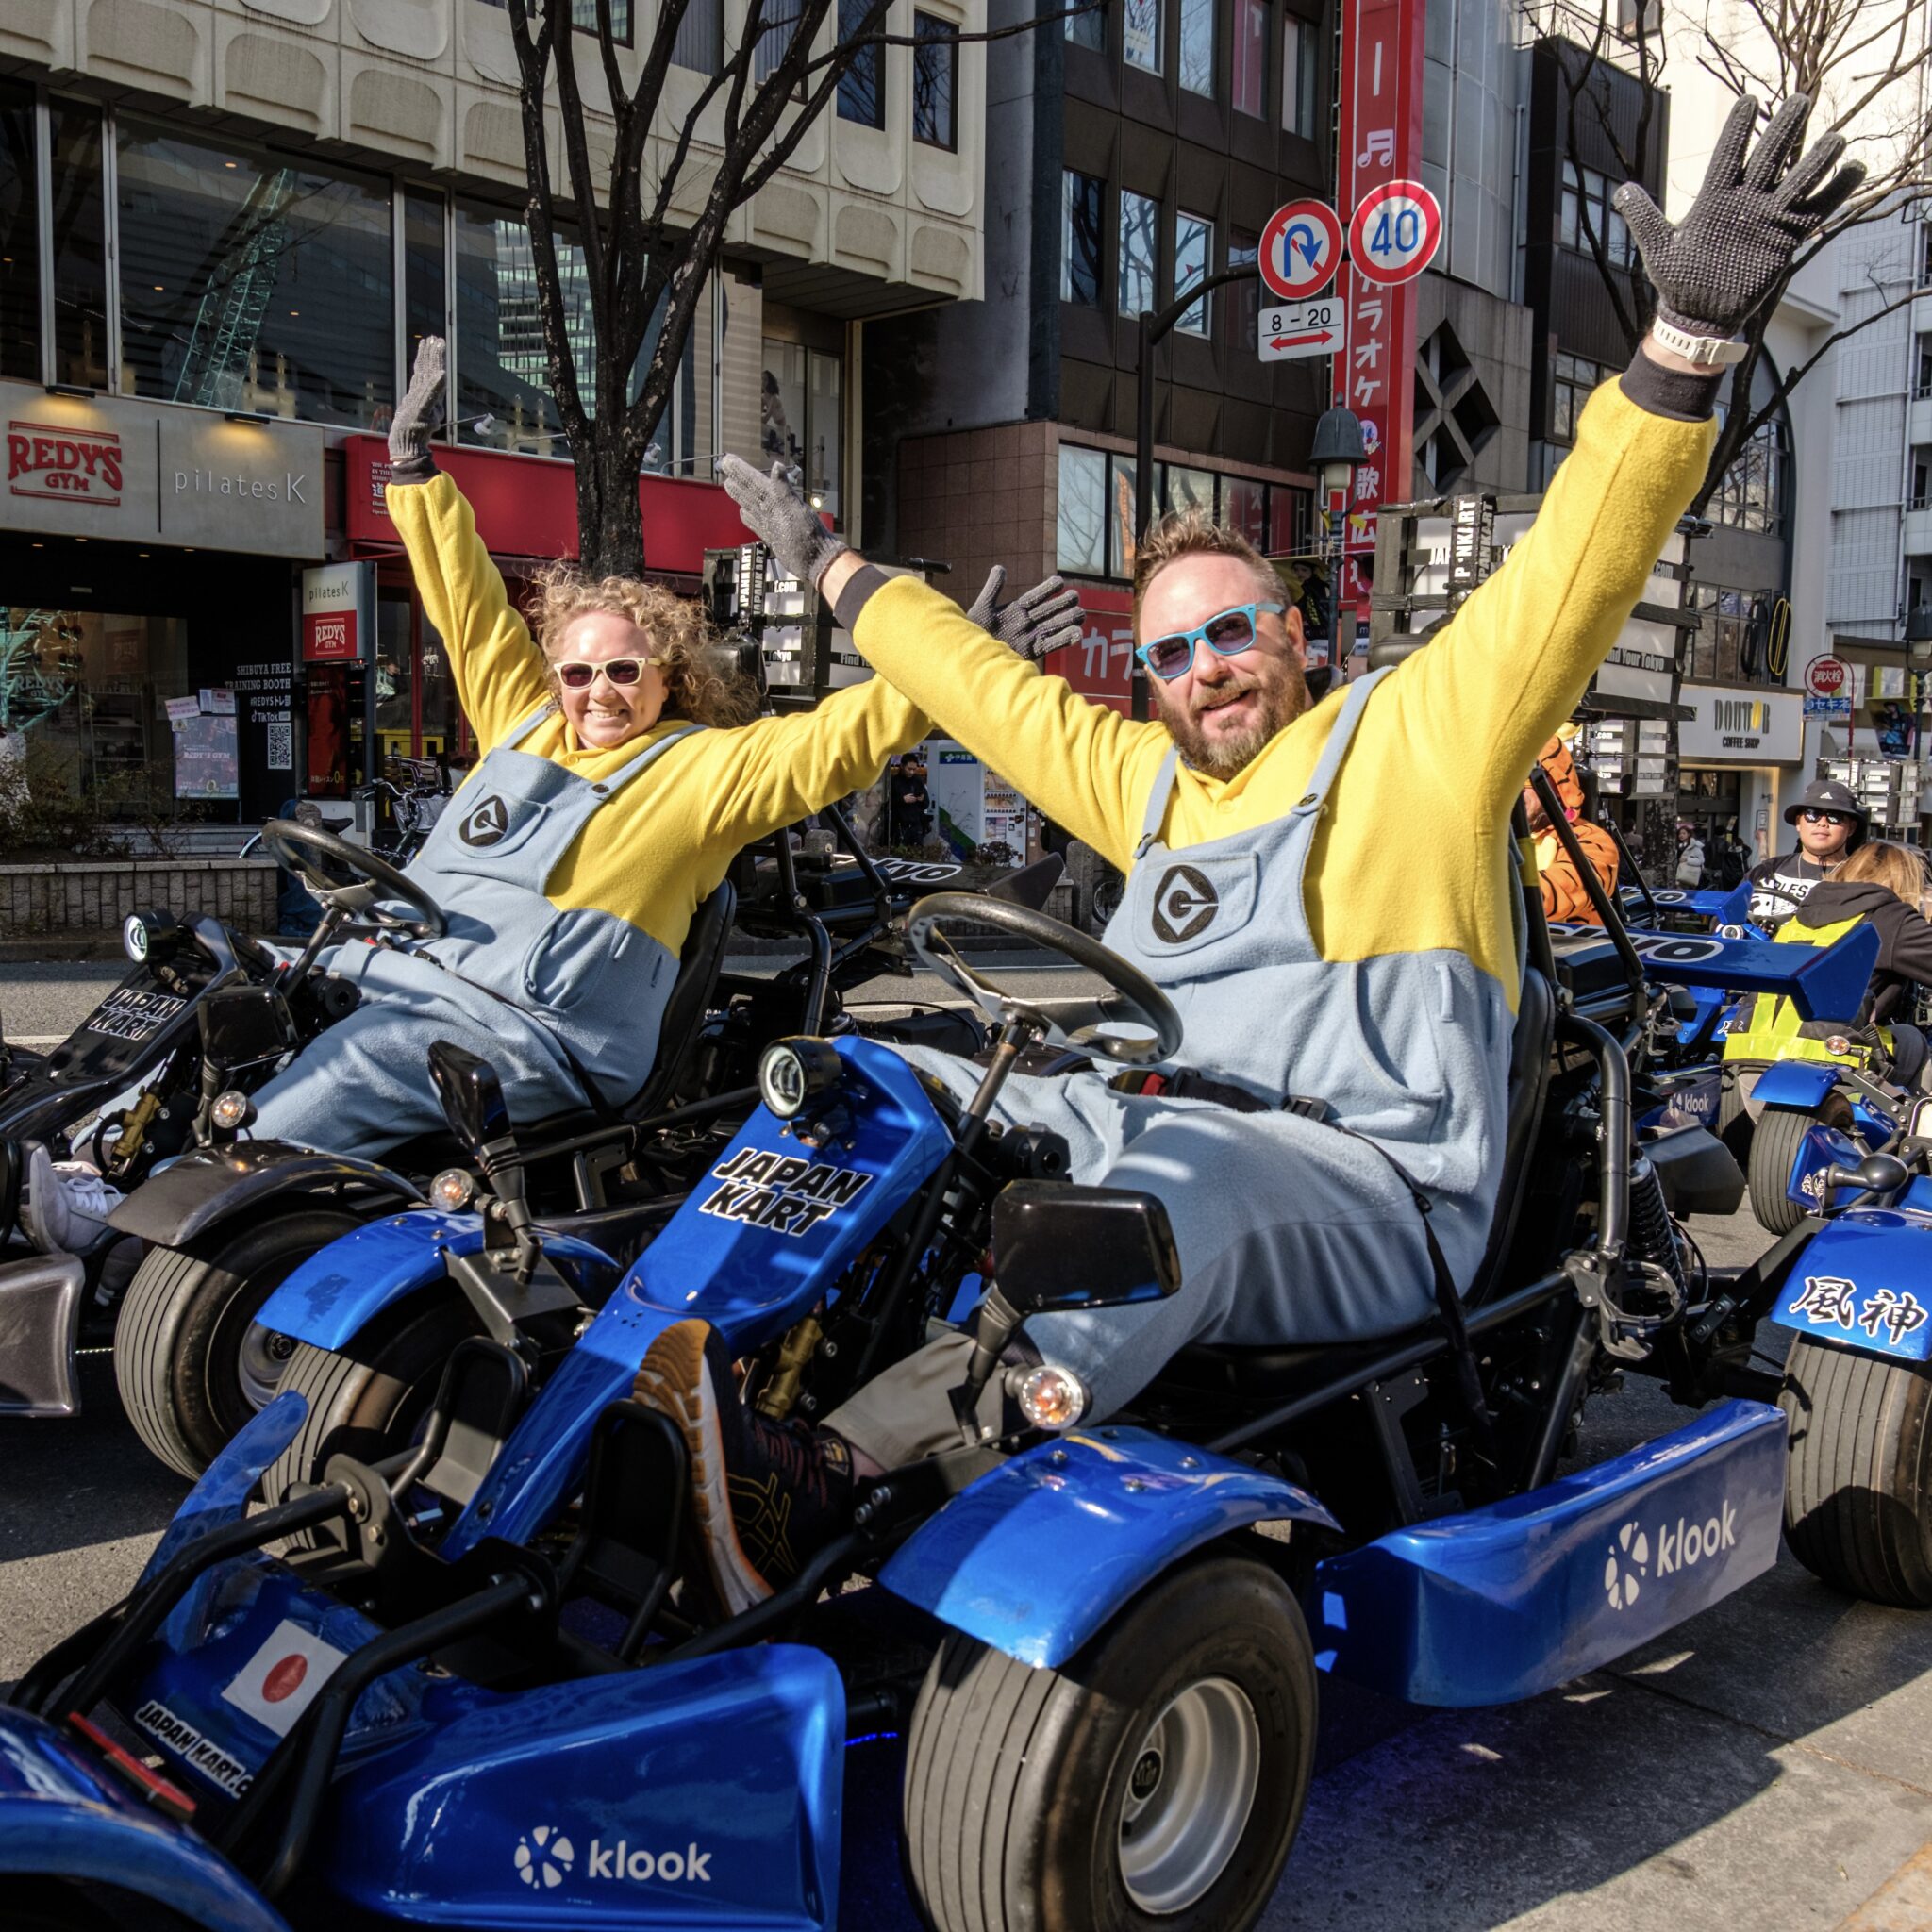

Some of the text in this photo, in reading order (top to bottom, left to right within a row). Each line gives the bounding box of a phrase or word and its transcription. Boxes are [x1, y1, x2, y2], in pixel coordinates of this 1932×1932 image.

[1370, 209, 1419, 256] 40
[45, 472, 90, 491] GYM
[237, 663, 291, 675] SHIBUYA FREE
[1622, 648, 1641, 667] Your
[1641, 652, 1665, 671] Tokyo
[225, 678, 291, 691] TRAINING BOOTH
[1813, 669, 1842, 683] 消火栓
[258, 711, 278, 723] TikTok
[1714, 699, 1770, 734] DOUTOR
[1723, 736, 1760, 749] COFFEE SHOP
[101, 989, 187, 1021] JAPAN
[88, 1010, 162, 1041] KART
[1685, 1093, 1709, 1113] klook
[711, 1147, 873, 1207] JAPAN
[698, 1181, 837, 1238] KART
[1789, 1276, 1928, 1345] 風神
[1657, 1499, 1736, 1578] klook
[135, 1700, 201, 1756] JAPAN
[588, 1839, 712, 1881] klook
